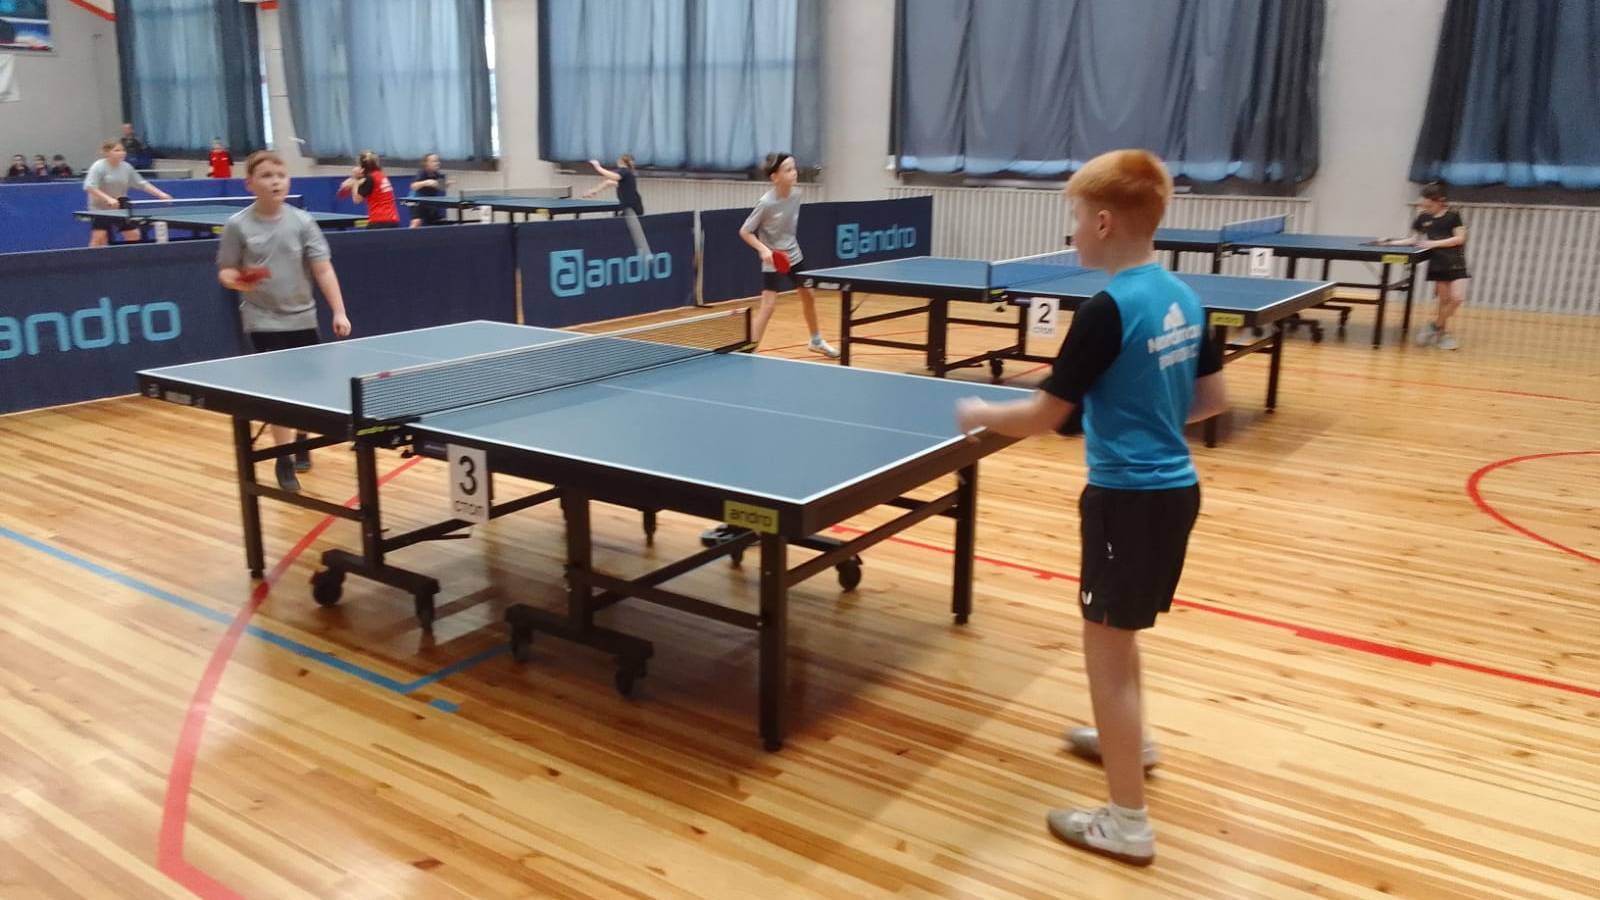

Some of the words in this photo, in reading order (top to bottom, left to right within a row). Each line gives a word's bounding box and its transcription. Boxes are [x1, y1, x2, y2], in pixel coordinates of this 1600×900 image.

[859, 224, 917, 254] andro
[586, 248, 672, 288] andro
[1038, 303, 1051, 324] 2
[459, 455, 477, 496] 3
